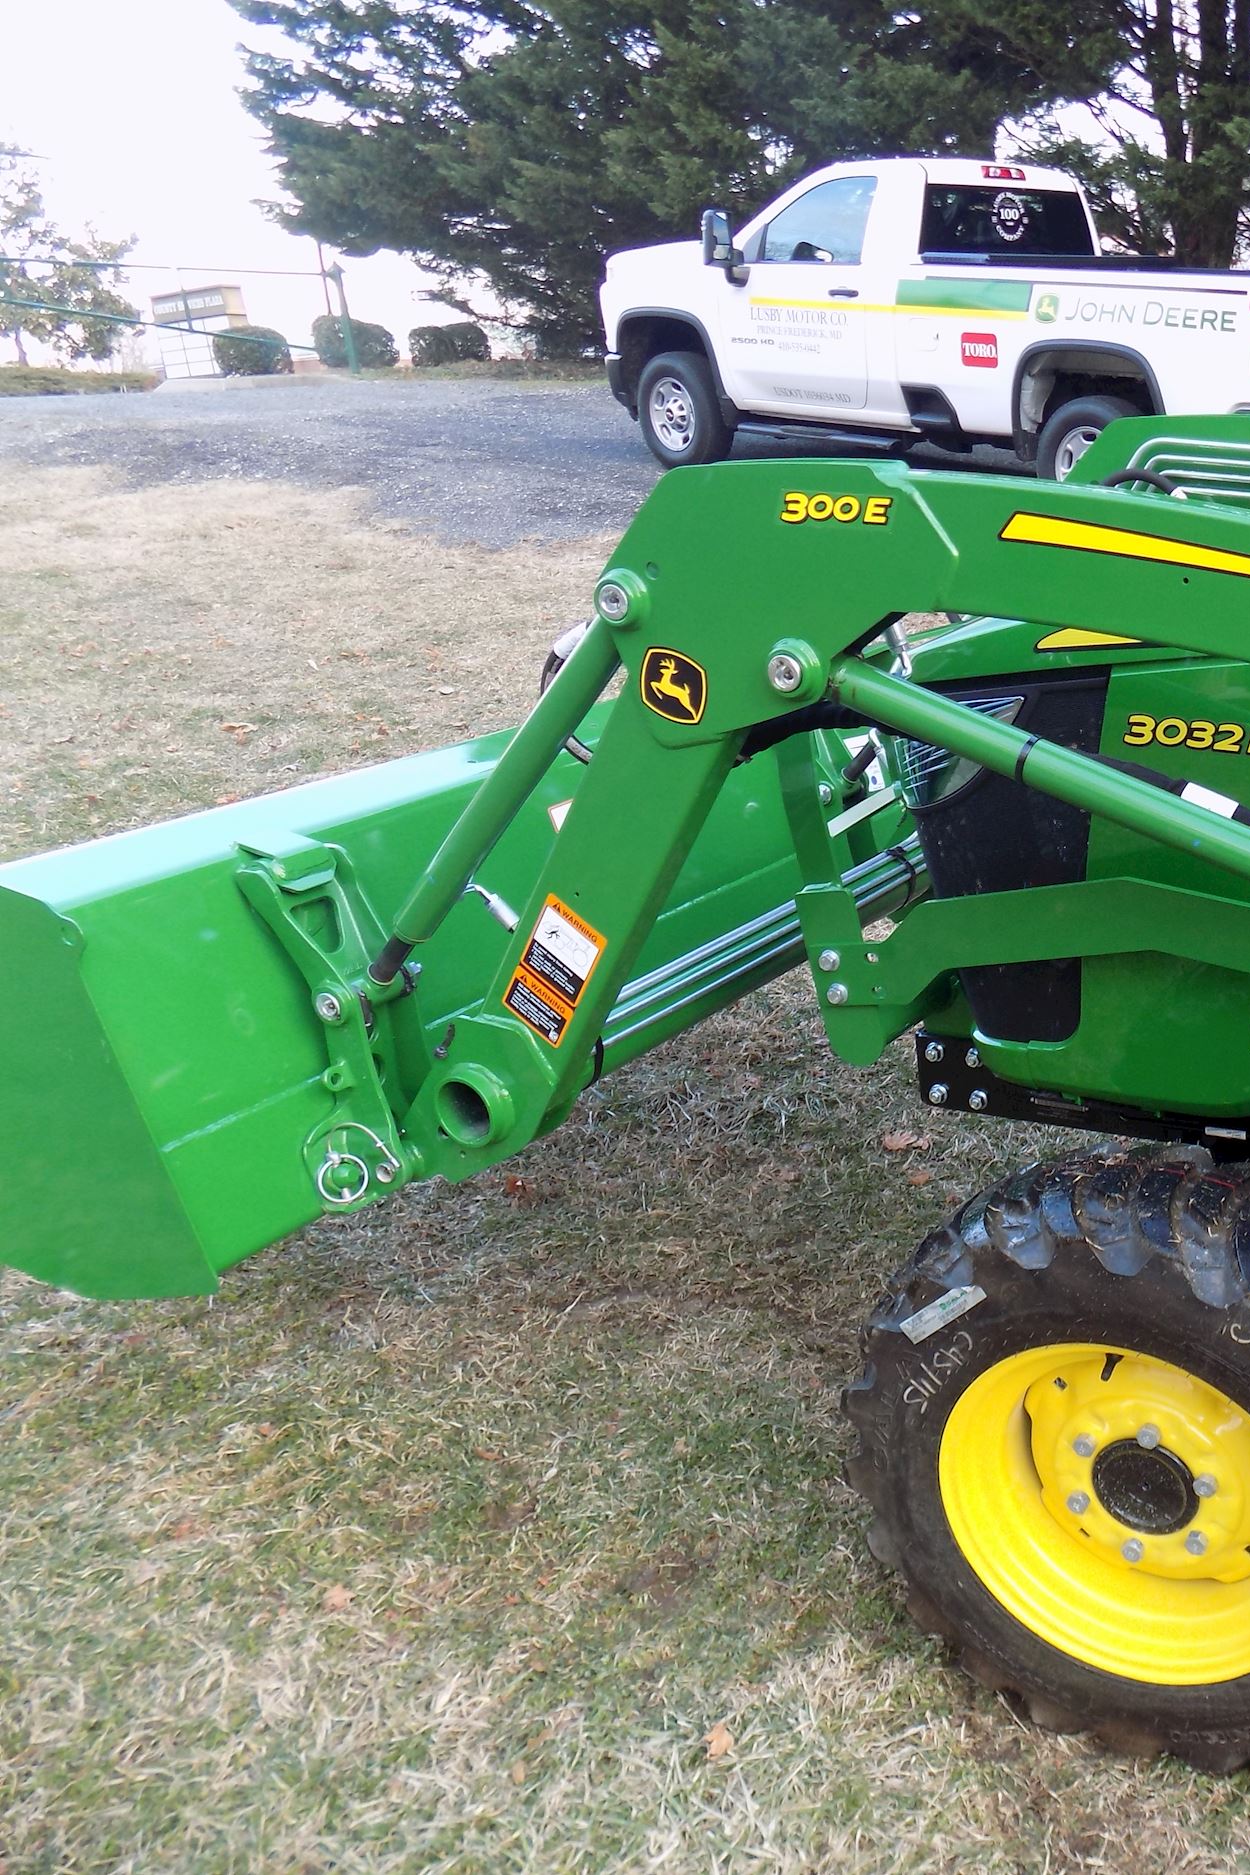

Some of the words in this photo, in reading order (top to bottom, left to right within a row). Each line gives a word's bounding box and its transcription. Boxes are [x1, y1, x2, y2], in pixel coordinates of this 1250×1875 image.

[1000, 208, 1020, 220] 100
[996, 225, 1025, 241] COMPANY
[750, 307, 782, 322] LUSBY
[784, 309, 828, 326] MOTOR
[1065, 298, 1136, 324] JOHN
[1143, 301, 1238, 333] DEERE
[731, 337, 758, 345] 2500
[760, 338, 775, 346] HD
[963, 342, 997, 358] TORO
[562, 909, 599, 944] WARNING
[530, 981, 567, 1015] WARNING
